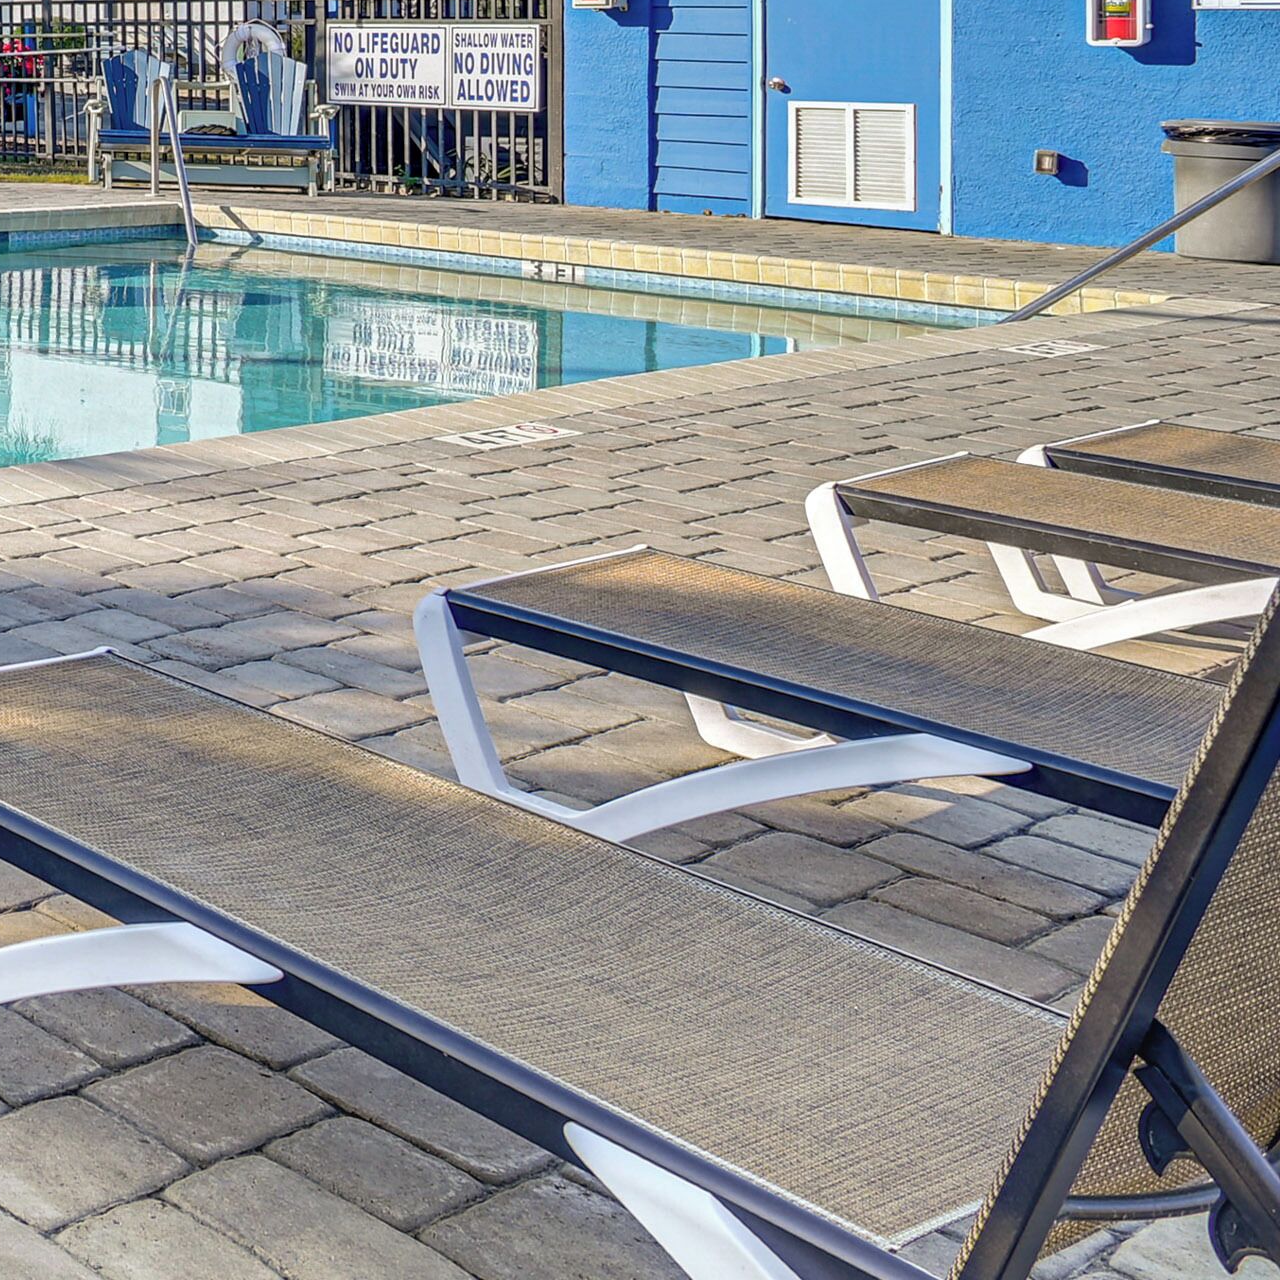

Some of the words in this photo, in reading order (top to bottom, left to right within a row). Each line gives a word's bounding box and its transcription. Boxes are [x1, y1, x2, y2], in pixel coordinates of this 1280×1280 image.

[334, 32, 353, 53] NO
[358, 32, 440, 54] LIFEGUARD
[454, 33, 498, 48] SHALLOW
[500, 33, 533, 48] WATER
[355, 57, 374, 78] ON
[380, 58, 418, 79] DUTY
[454, 52, 474, 74] NO
[480, 52, 533, 76] DIVING
[335, 83, 356, 96] SWIM
[359, 84, 369, 97] AT
[371, 84, 394, 98] YOUR
[396, 85, 416, 98] OWN
[419, 85, 440, 100] RISK
[457, 79, 530, 102] ALLOWED
